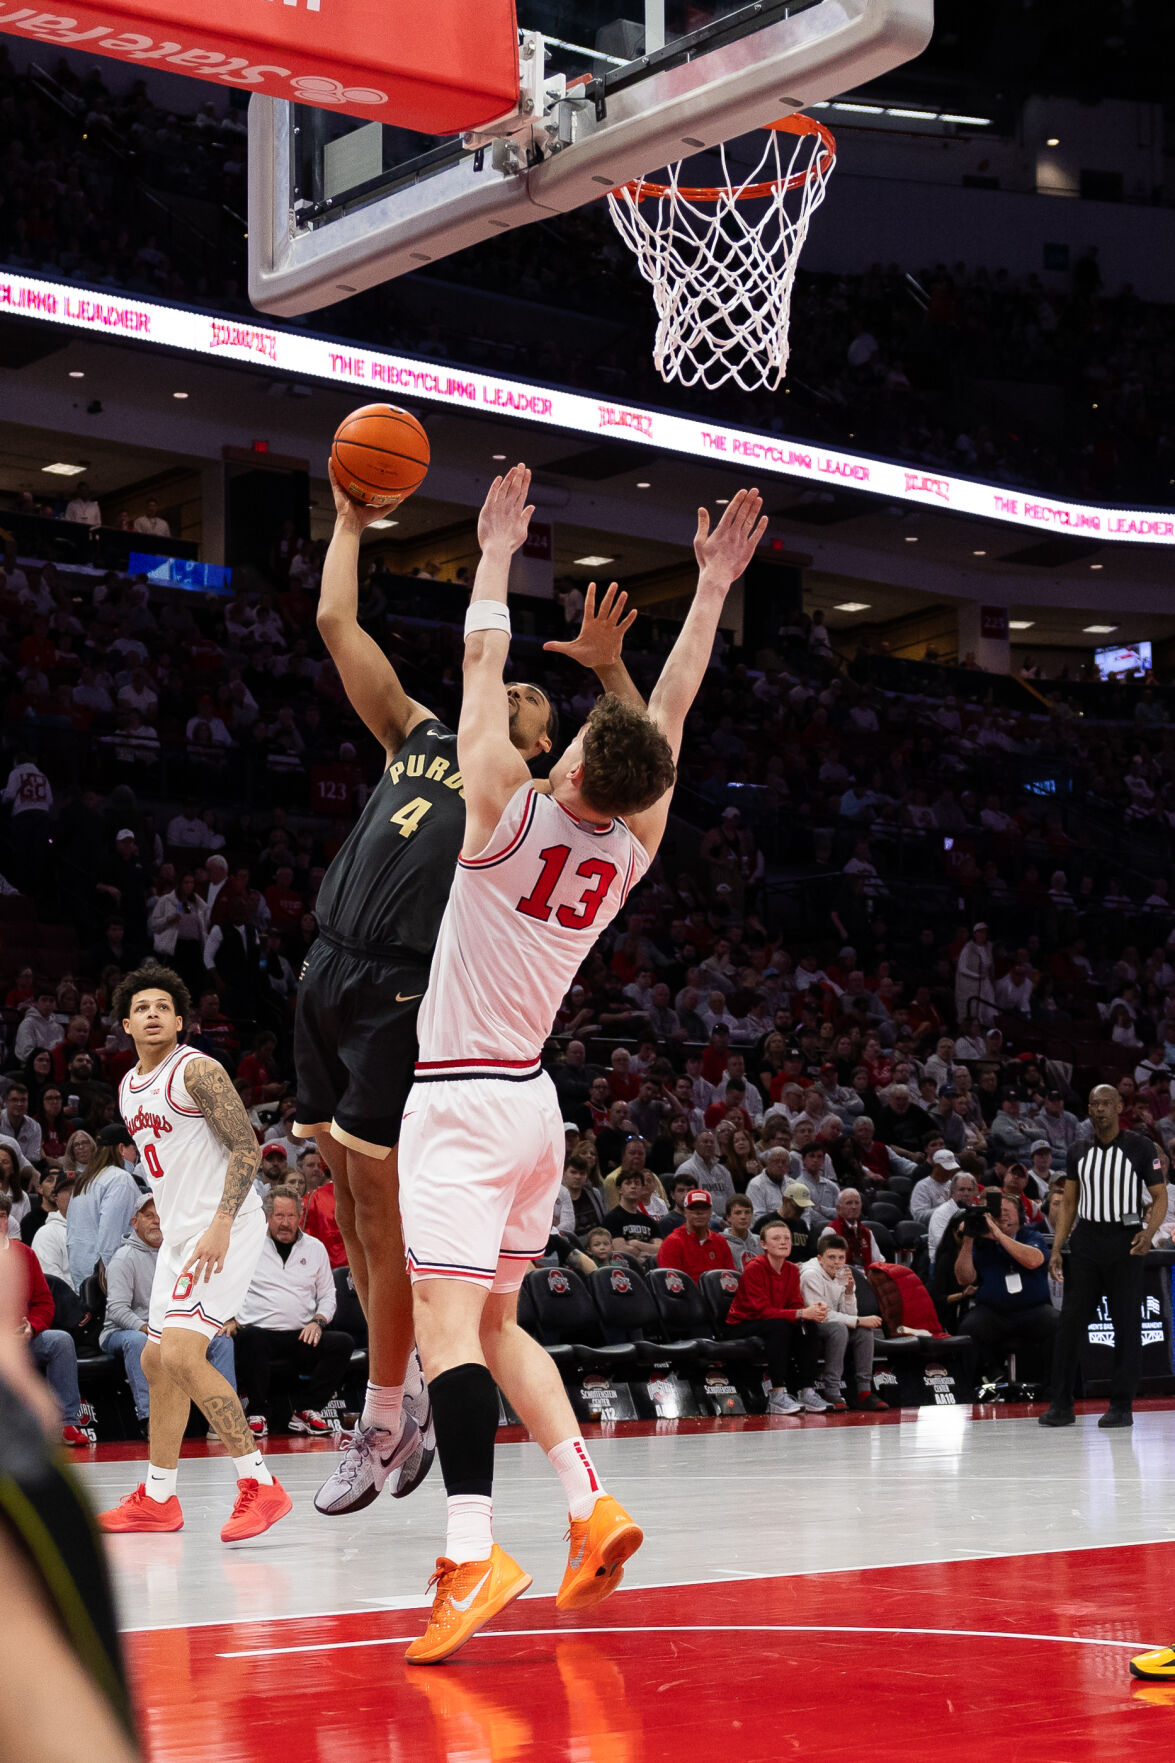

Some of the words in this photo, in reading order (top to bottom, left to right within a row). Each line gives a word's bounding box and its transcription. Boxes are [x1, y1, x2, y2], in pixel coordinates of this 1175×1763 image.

[100, 33, 292, 84] State
[64, 296, 151, 333] LEADER
[328, 353, 364, 378] THE
[371, 361, 476, 401] RECYCLING
[482, 384, 552, 417] LEADER
[701, 432, 727, 452] THE
[732, 438, 812, 470] RECYCLING
[817, 456, 870, 482] LEADER
[993, 496, 1018, 515] THE
[1024, 502, 1101, 531] RECYCLING
[1107, 517, 1174, 537] LEADER
[317, 781, 347, 800] 123
[390, 796, 433, 838] 4
[515, 844, 617, 930] 13
[144, 1144, 164, 1179] 0
